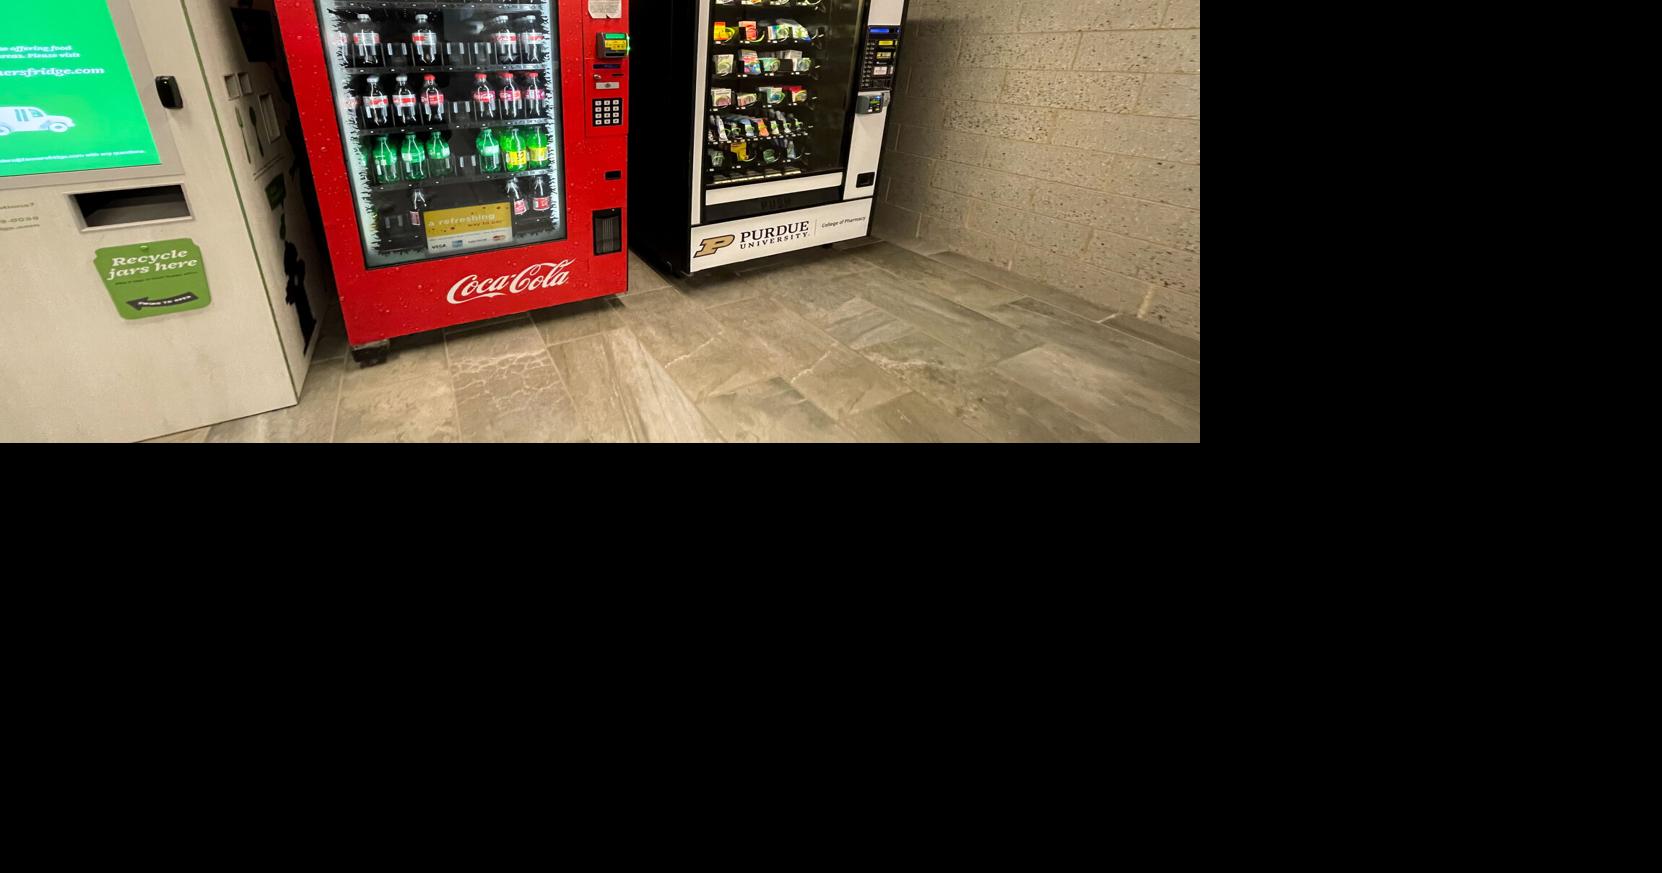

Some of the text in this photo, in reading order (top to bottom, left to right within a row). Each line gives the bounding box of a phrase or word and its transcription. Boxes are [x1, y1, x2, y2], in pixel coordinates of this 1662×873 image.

[51, 45, 72, 53] food
[0, 67, 104, 78] ersfridge.com
[439, 214, 496, 226] refreshing
[821, 221, 838, 229] College
[739, 231, 809, 250] UNIVERSITY
[740, 220, 809, 243] PURDUE
[693, 234, 735, 258] P
[112, 249, 188, 267] Recycle
[106, 265, 150, 281] jars
[155, 259, 198, 272] here
[446, 257, 576, 305] Coca-Cola
